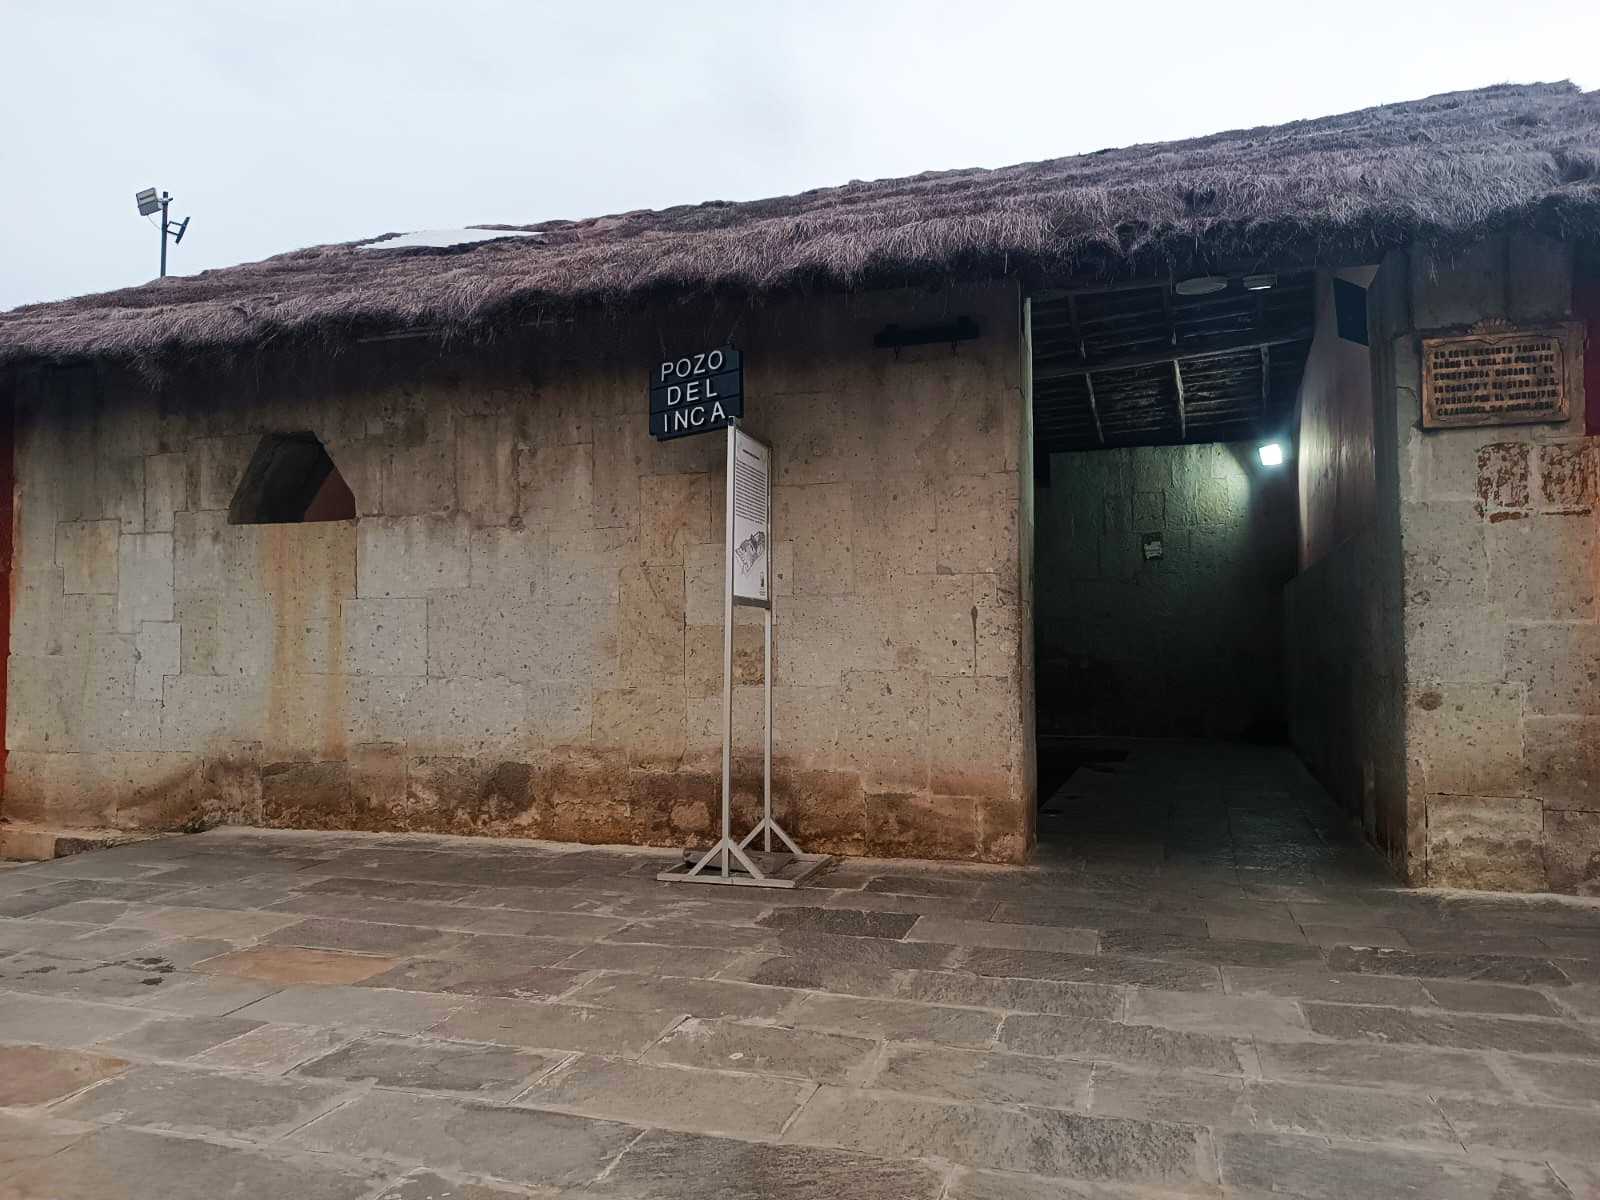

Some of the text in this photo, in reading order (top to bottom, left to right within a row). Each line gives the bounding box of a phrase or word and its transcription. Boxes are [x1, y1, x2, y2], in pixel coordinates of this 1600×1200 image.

[661, 350, 723, 382] POZO
[667, 378, 718, 406] DEL
[664, 401, 726, 433] INCA
